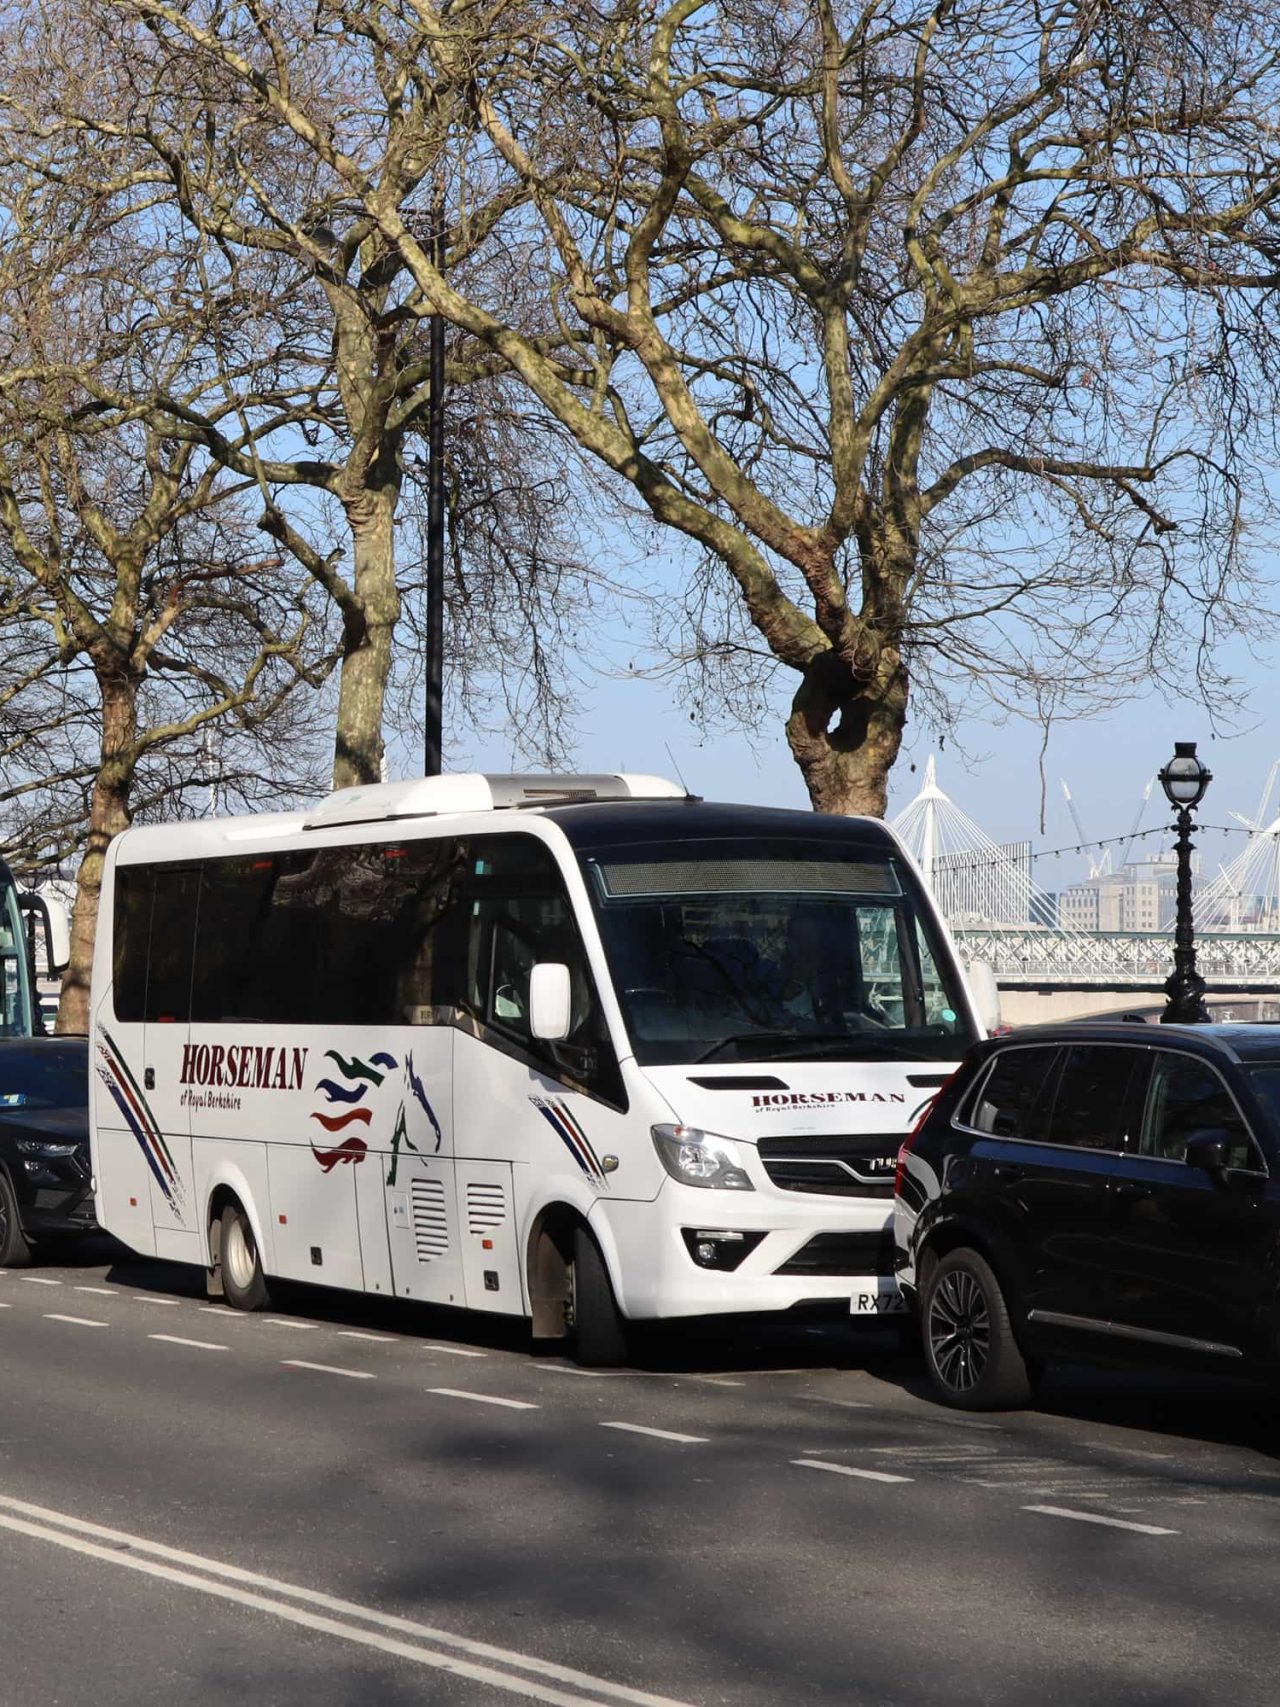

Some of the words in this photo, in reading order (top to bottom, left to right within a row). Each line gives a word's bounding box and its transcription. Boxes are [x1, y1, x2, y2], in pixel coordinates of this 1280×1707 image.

[179, 1044, 309, 1090] HORSEMAN
[180, 1090, 188, 1106] of
[188, 1089, 207, 1112] Royal
[207, 1091, 241, 1110] Berkshire
[751, 1092, 906, 1107] HORSEMAN
